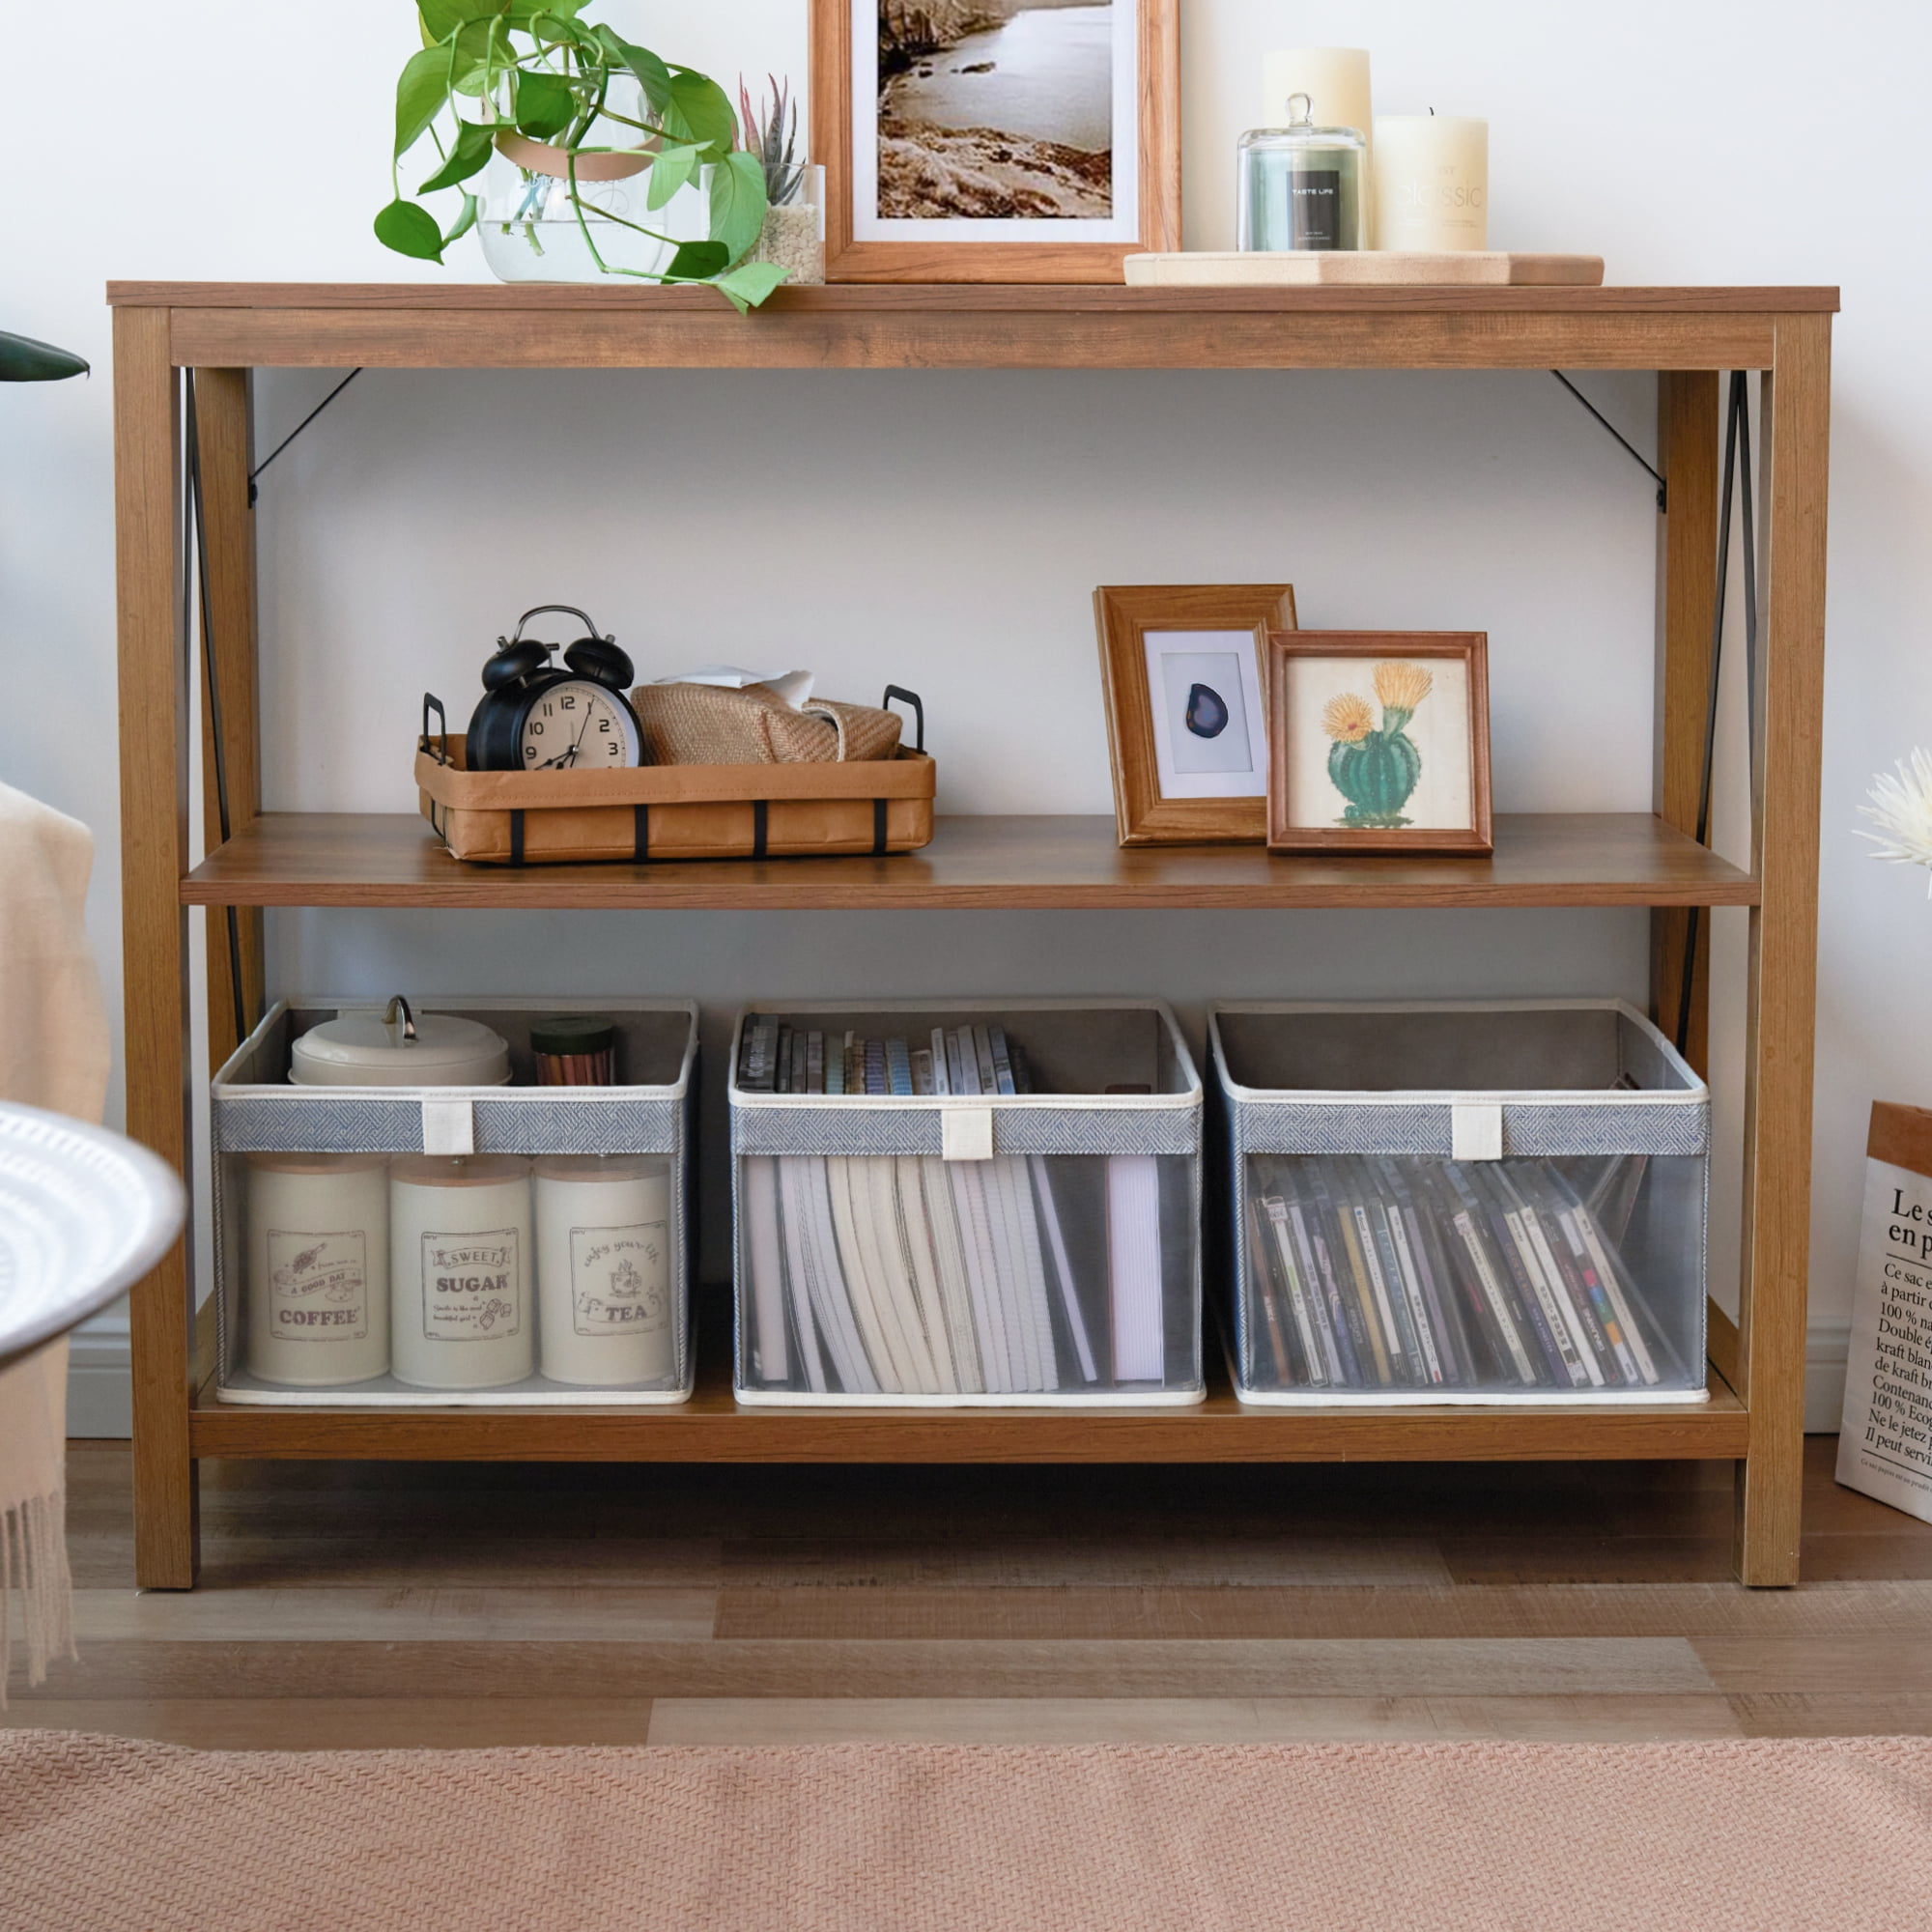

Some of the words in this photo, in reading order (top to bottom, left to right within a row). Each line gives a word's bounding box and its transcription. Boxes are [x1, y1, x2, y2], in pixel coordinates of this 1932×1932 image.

[543, 702, 554, 717] 11
[560, 696, 576, 710] 12
[529, 722, 544, 735] 10
[599, 719, 610, 732] 2
[525, 746, 537, 760] 9
[608, 742, 618, 755] 3
[1891, 1188, 1923, 1222] Le
[1889, 1224, 1916, 1247] en
[450, 1251, 497, 1264] SWEET
[437, 1274, 508, 1293] SUGAR
[1885, 1263, 1902, 1280] Ce
[1904, 1272, 1923, 1287] sac
[1881, 1281, 1888, 1295] à
[1890, 1287, 1927, 1307] partir
[279, 1308, 358, 1326] COFFEE
[606, 1305, 648, 1321] TEA
[1881, 1301, 1902, 1321] 100
[1905, 1309, 1917, 1325] %
[1879, 1318, 1923, 1347] Double
[1876, 1336, 1905, 1360] kraft
[1907, 1347, 1932, 1370] blan
[1874, 1355, 1890, 1373] de
[1891, 1360, 1919, 1384] kraft
[1872, 1391, 1892, 1410] 100
[1894, 1400, 1906, 1416] %
[1868, 1407, 1887, 1428] Ne
[1889, 1414, 1899, 1433] le
[1899, 1421, 1927, 1444] jetez
[1864, 1426, 1876, 1442] Il
[1875, 1434, 1903, 1454] peut
[1903, 1446, 1932, 1467] servi
